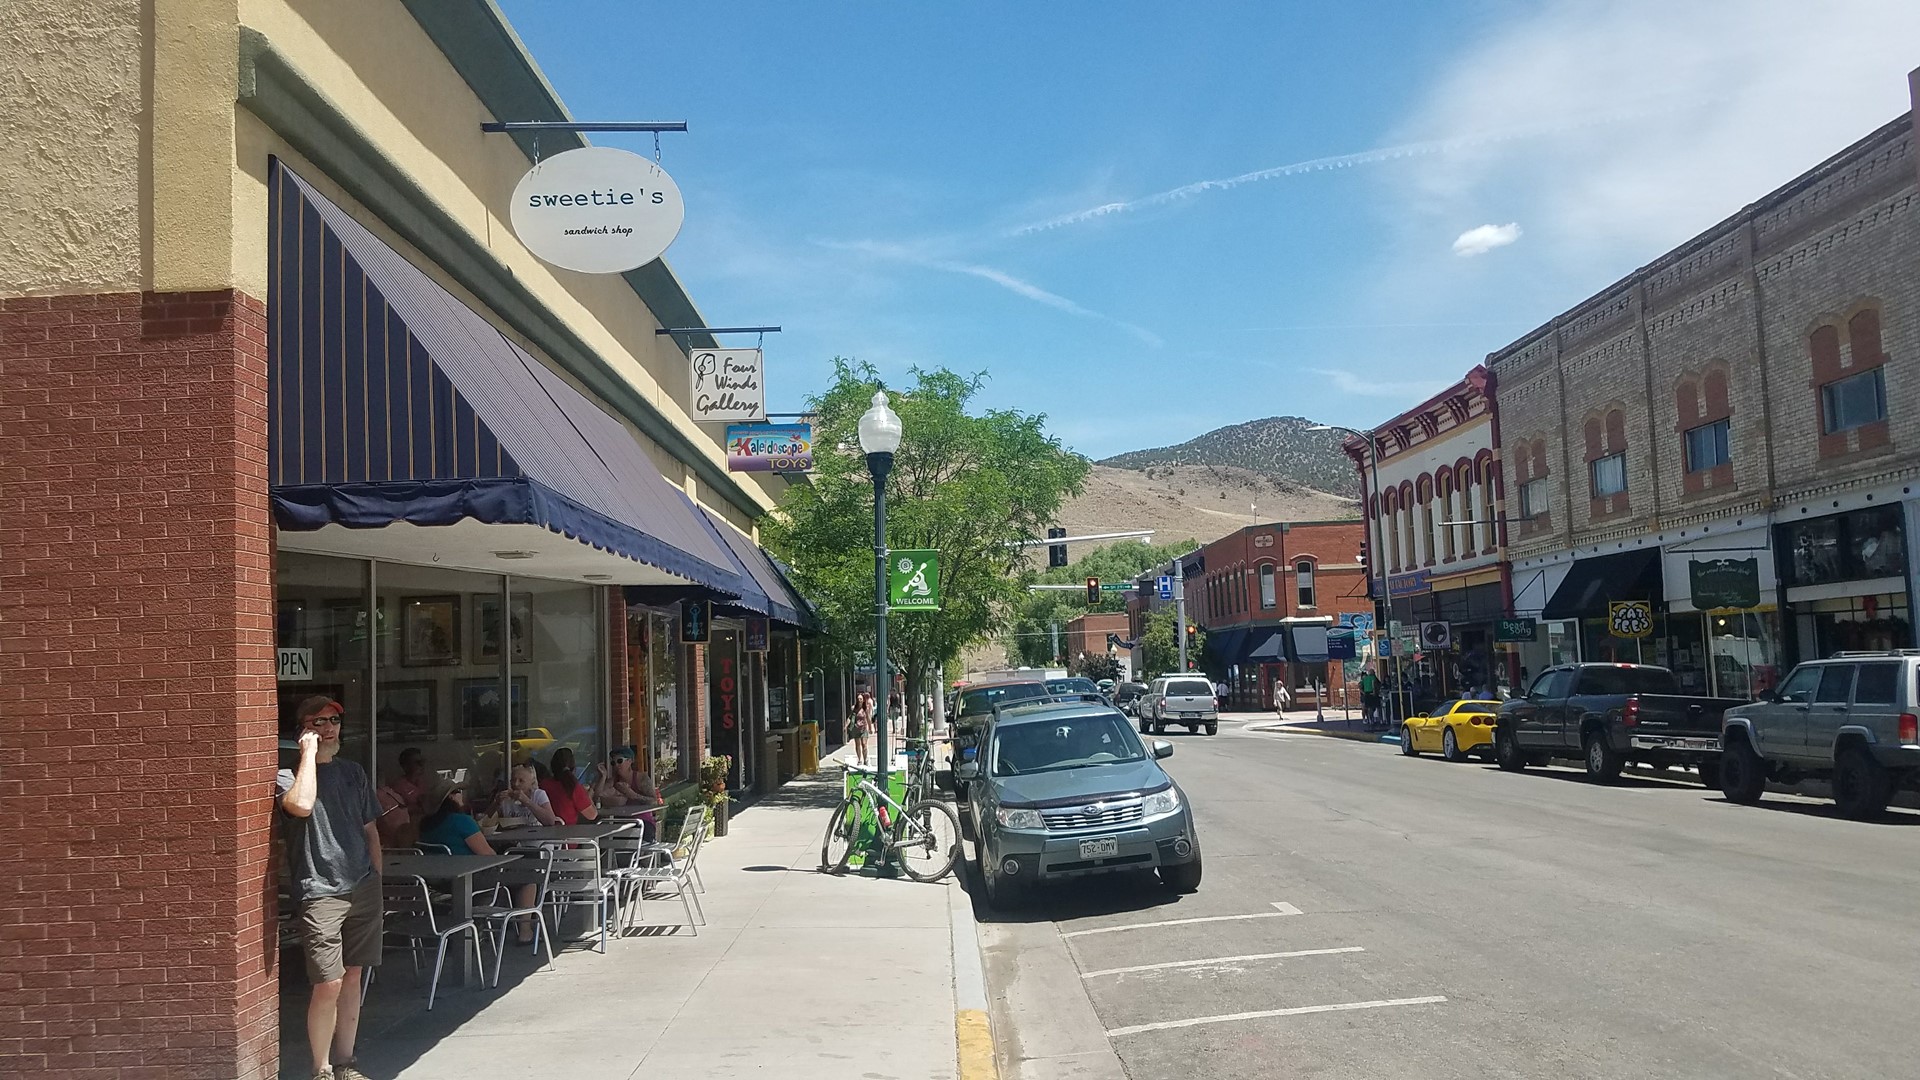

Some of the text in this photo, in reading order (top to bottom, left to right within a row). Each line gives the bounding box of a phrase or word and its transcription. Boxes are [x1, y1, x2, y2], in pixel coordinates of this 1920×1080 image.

[529, 188, 664, 207] sweetie's
[564, 225, 633, 237] sandwich shop
[723, 357, 757, 374] Four
[715, 374, 757, 390] Winds
[696, 393, 759, 417] Gallery
[737, 437, 803, 456] Kaleidoscope
[767, 458, 808, 469] TOYS
[1619, 608, 1643, 618] FAT
[1503, 620, 1525, 629] Bead
[1614, 618, 1648, 633] TEES
[277, 652, 308, 676] PEN
[721, 658, 734, 729] TOYS
